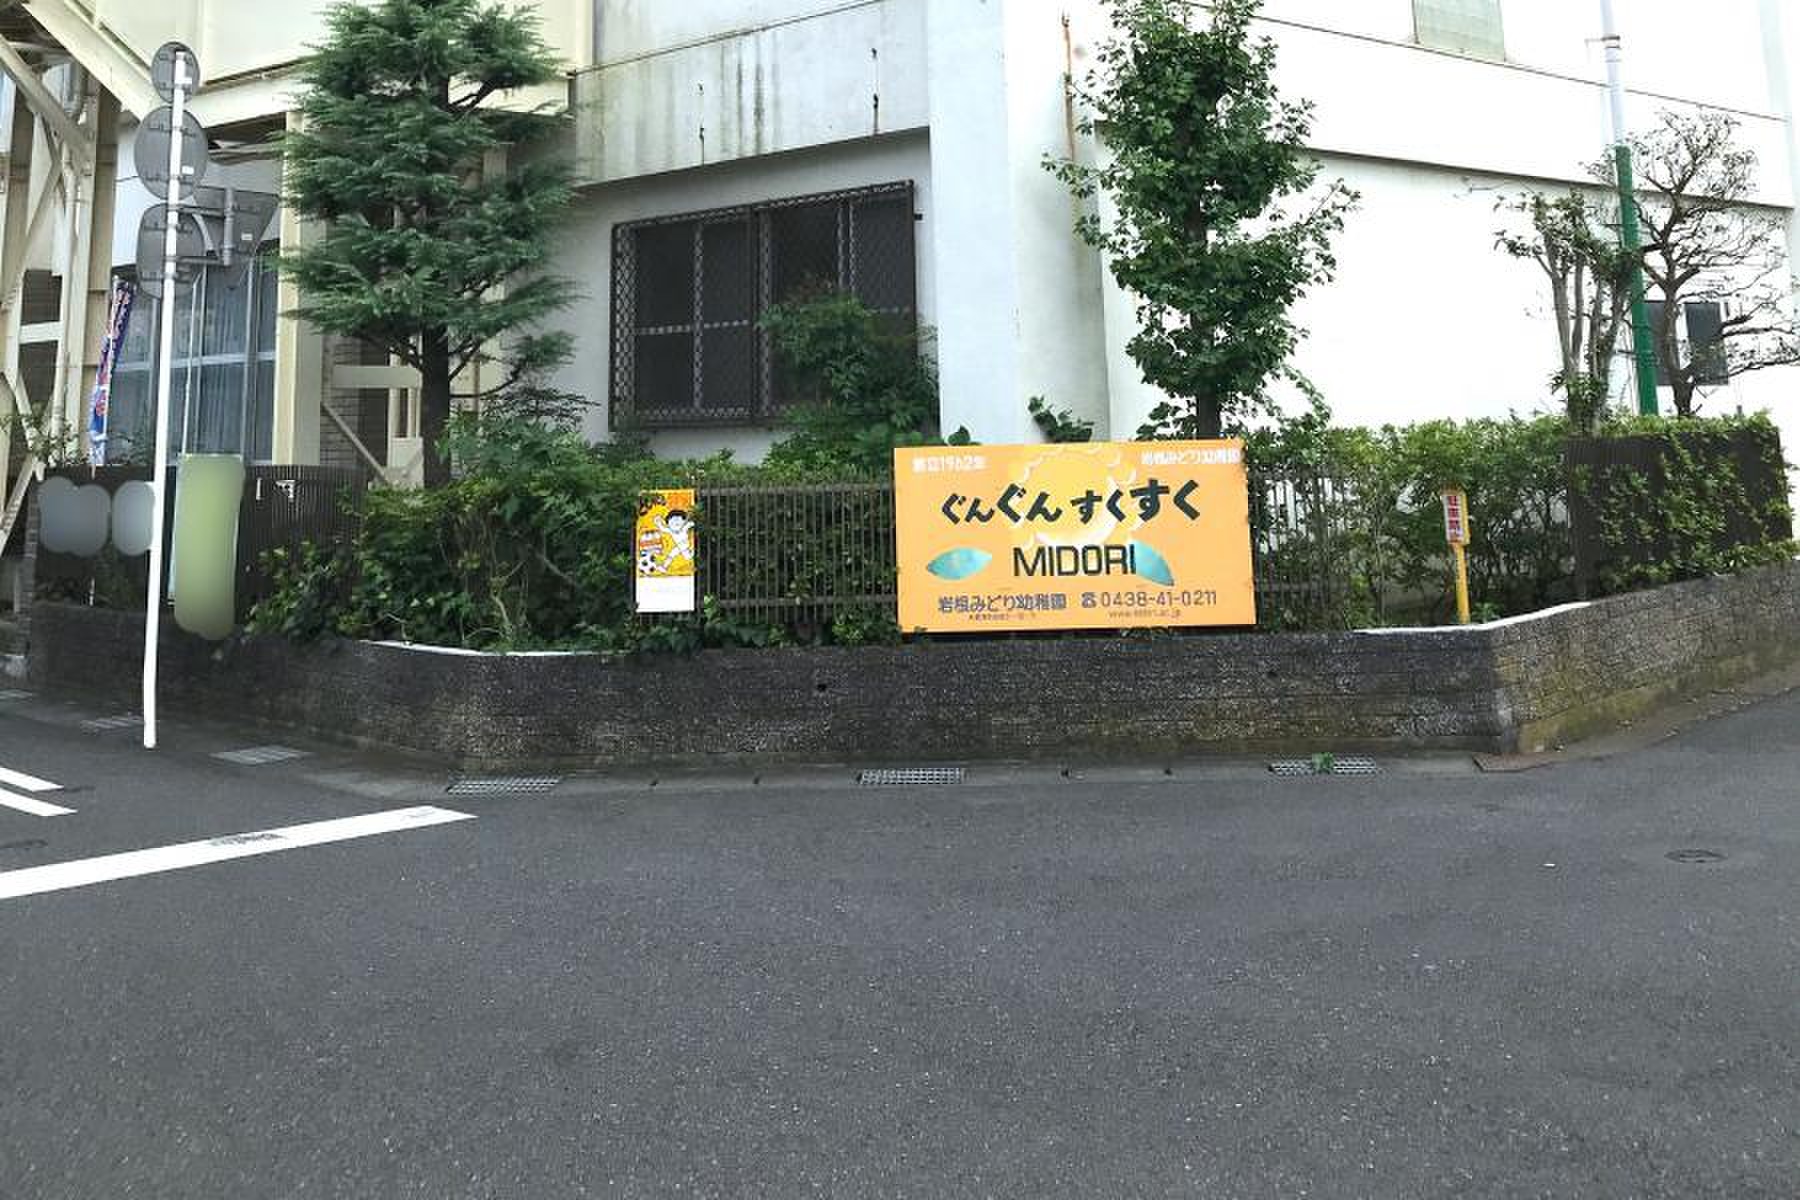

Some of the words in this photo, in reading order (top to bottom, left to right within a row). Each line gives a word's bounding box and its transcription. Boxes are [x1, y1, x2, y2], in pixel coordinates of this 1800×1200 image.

[1012, 544, 1136, 577] MIDORI
[938, 593, 1067, 613] 岩根みどり幼稚園
